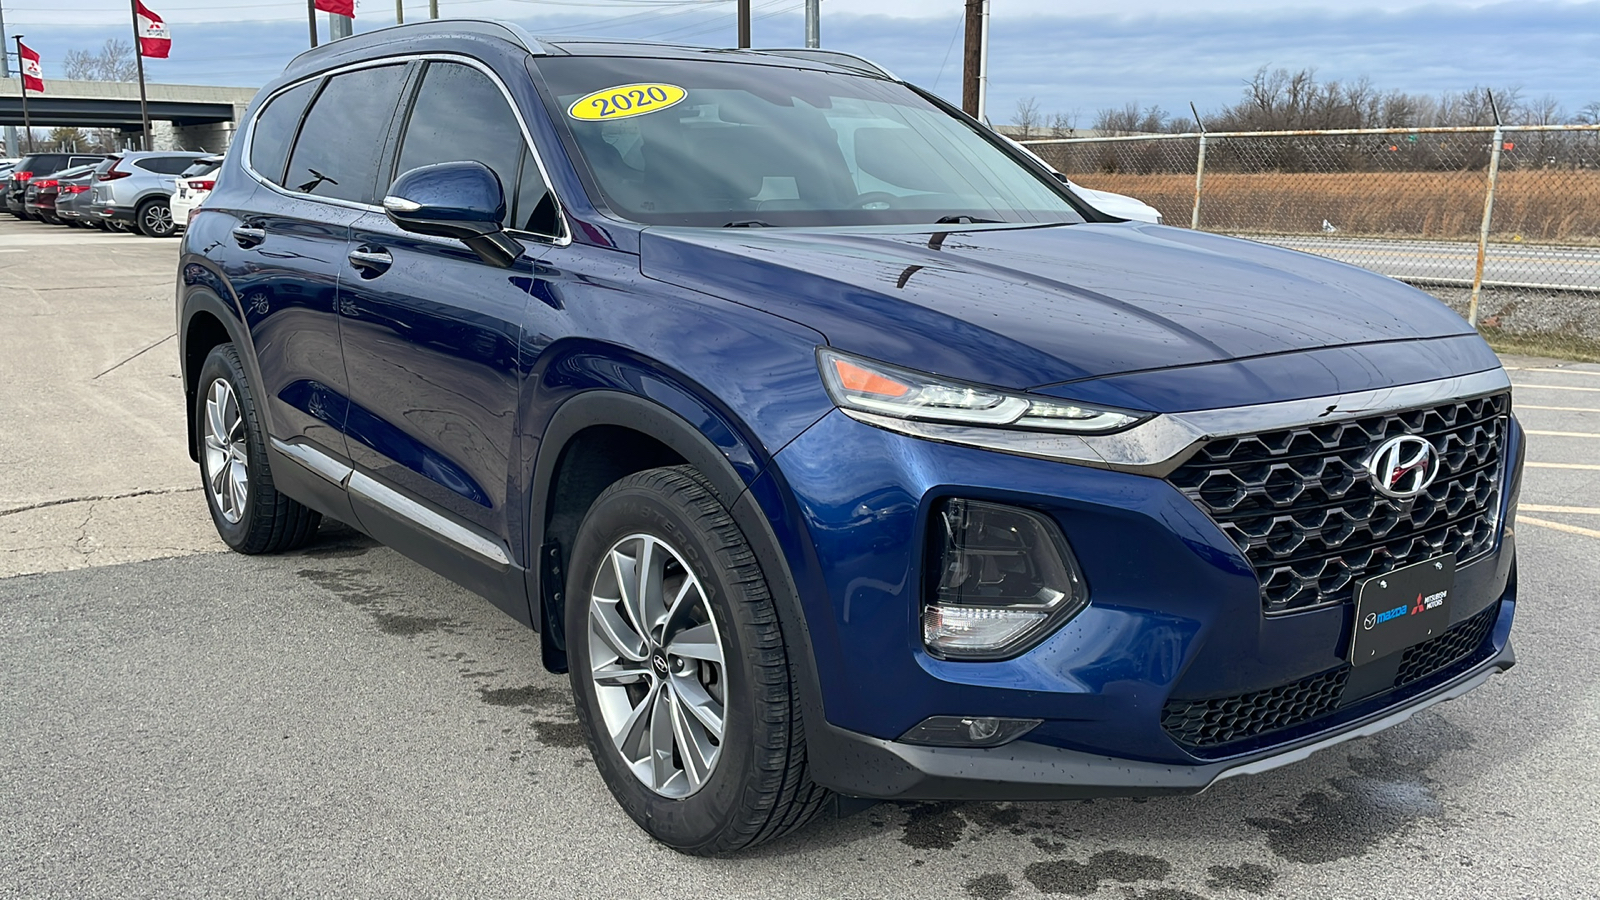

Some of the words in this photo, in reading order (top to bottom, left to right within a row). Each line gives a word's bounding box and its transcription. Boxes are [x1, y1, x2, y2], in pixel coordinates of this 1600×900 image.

[592, 86, 667, 117] 2020
[619, 501, 734, 648] MASTERCRAFT
[1377, 604, 1408, 624] mazda
